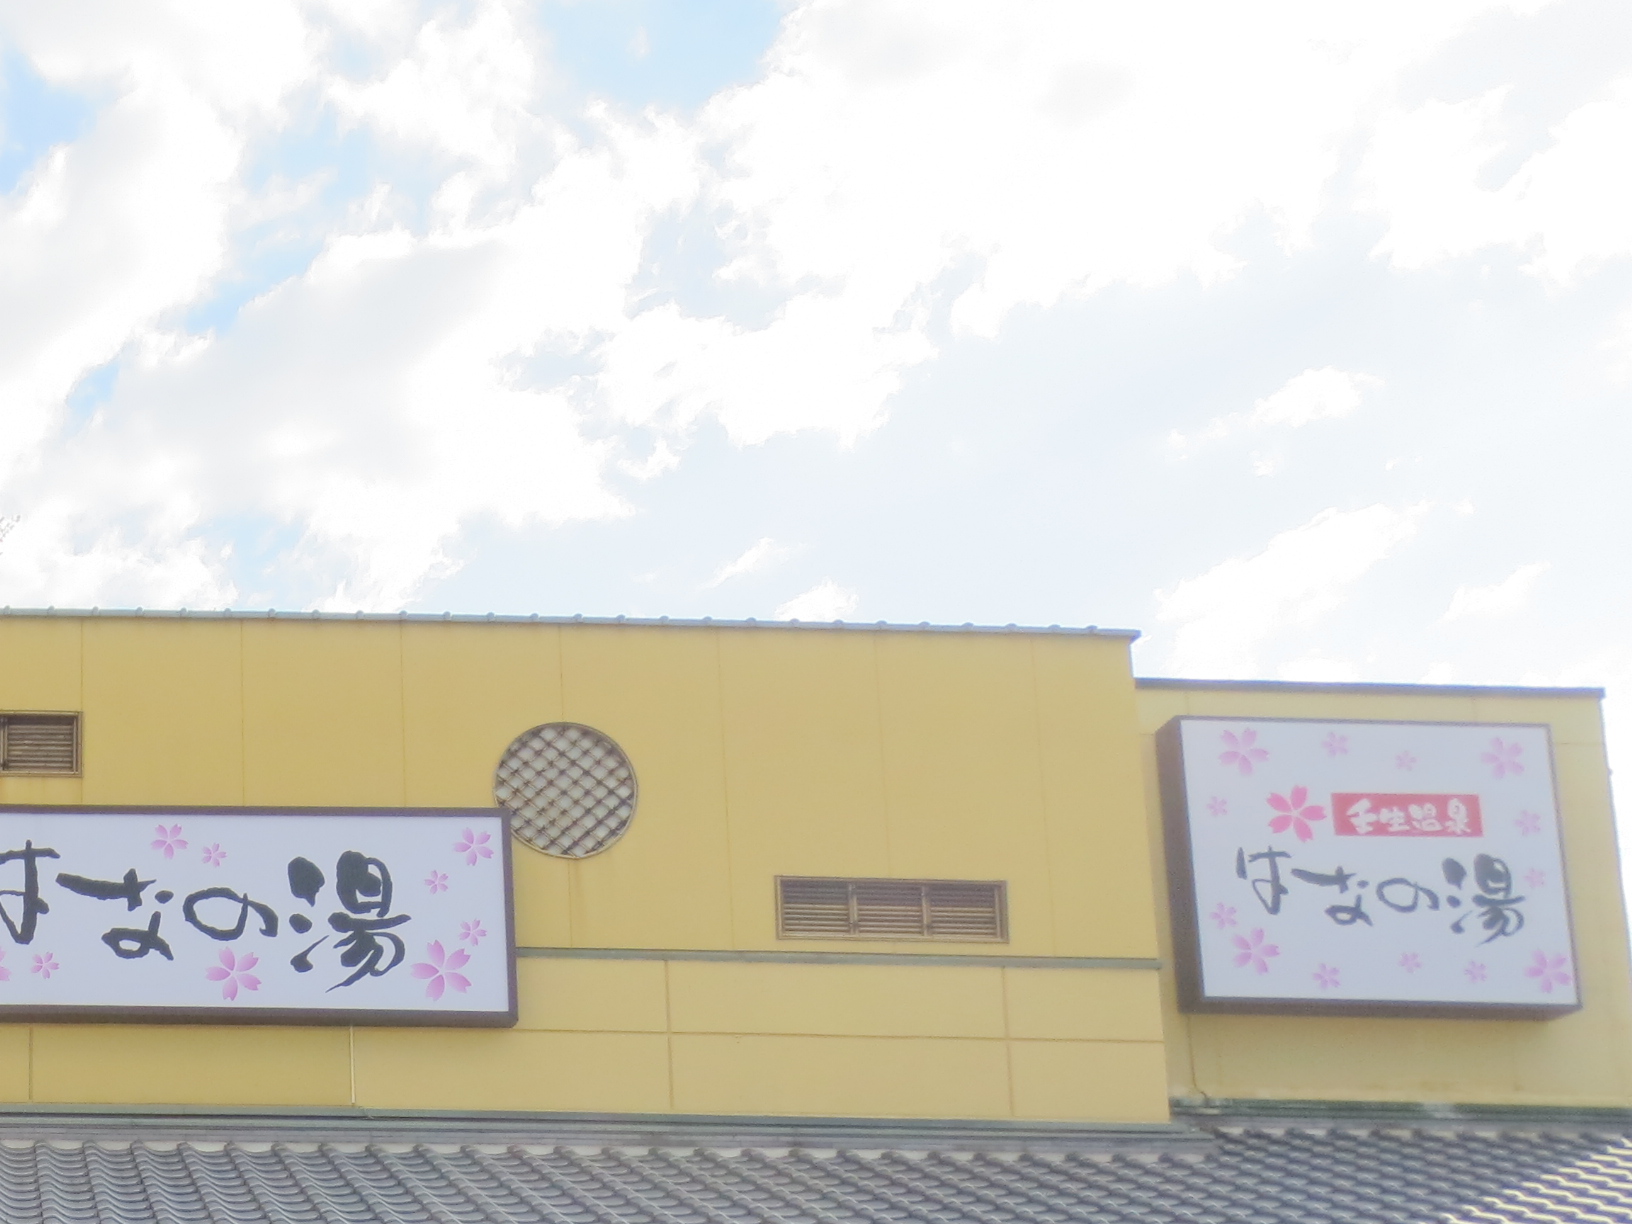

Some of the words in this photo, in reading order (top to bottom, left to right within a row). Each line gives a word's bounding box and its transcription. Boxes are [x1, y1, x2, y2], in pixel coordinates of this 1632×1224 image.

[1344, 798, 1472, 835] 壬生温泉
[1236, 846, 1526, 945] はなの湯
